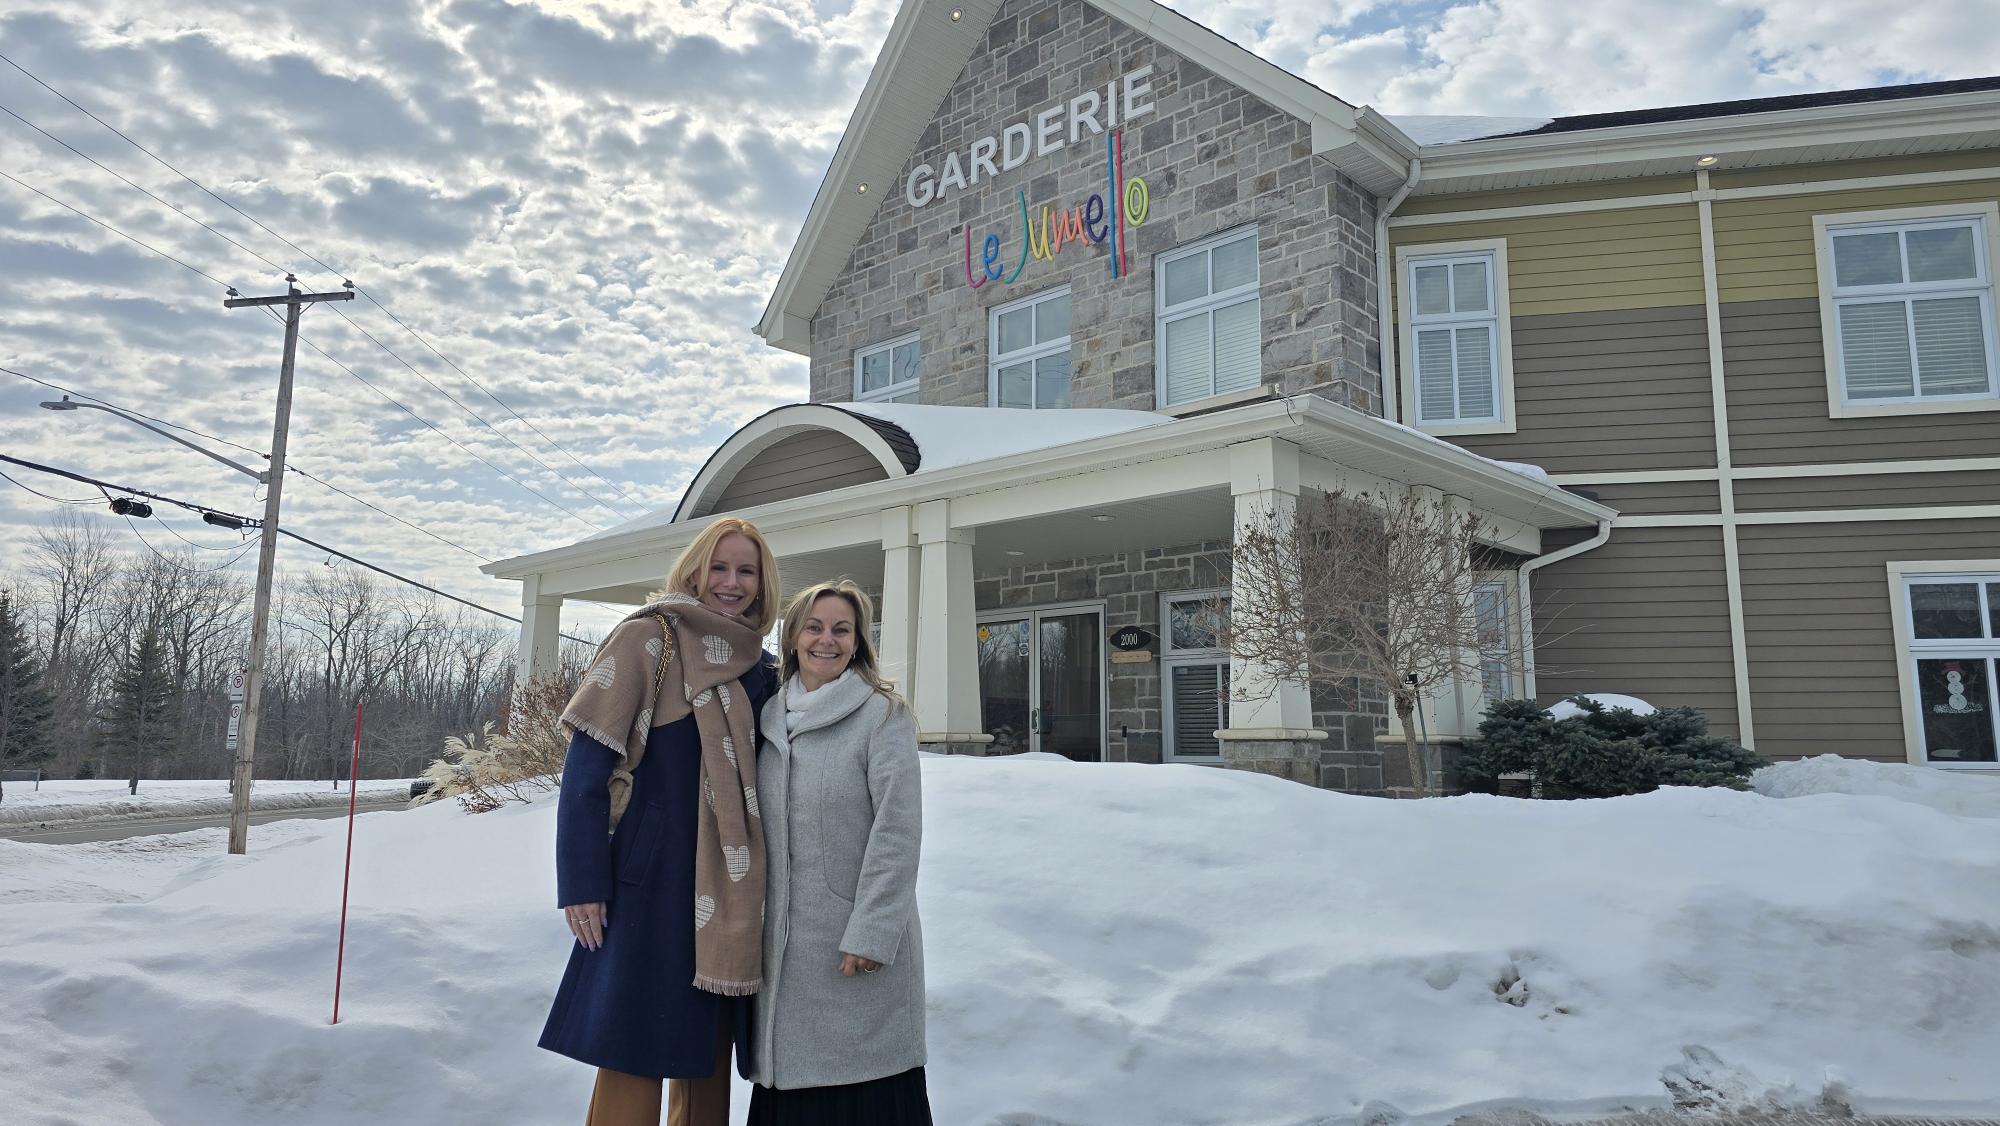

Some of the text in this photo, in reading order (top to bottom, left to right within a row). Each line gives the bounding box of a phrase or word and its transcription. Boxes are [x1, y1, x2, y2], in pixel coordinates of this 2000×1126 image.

[905, 64, 1156, 208] GARDERIE
[1003, 129, 1149, 285] Jumello
[1120, 633, 1138, 646] 2000
